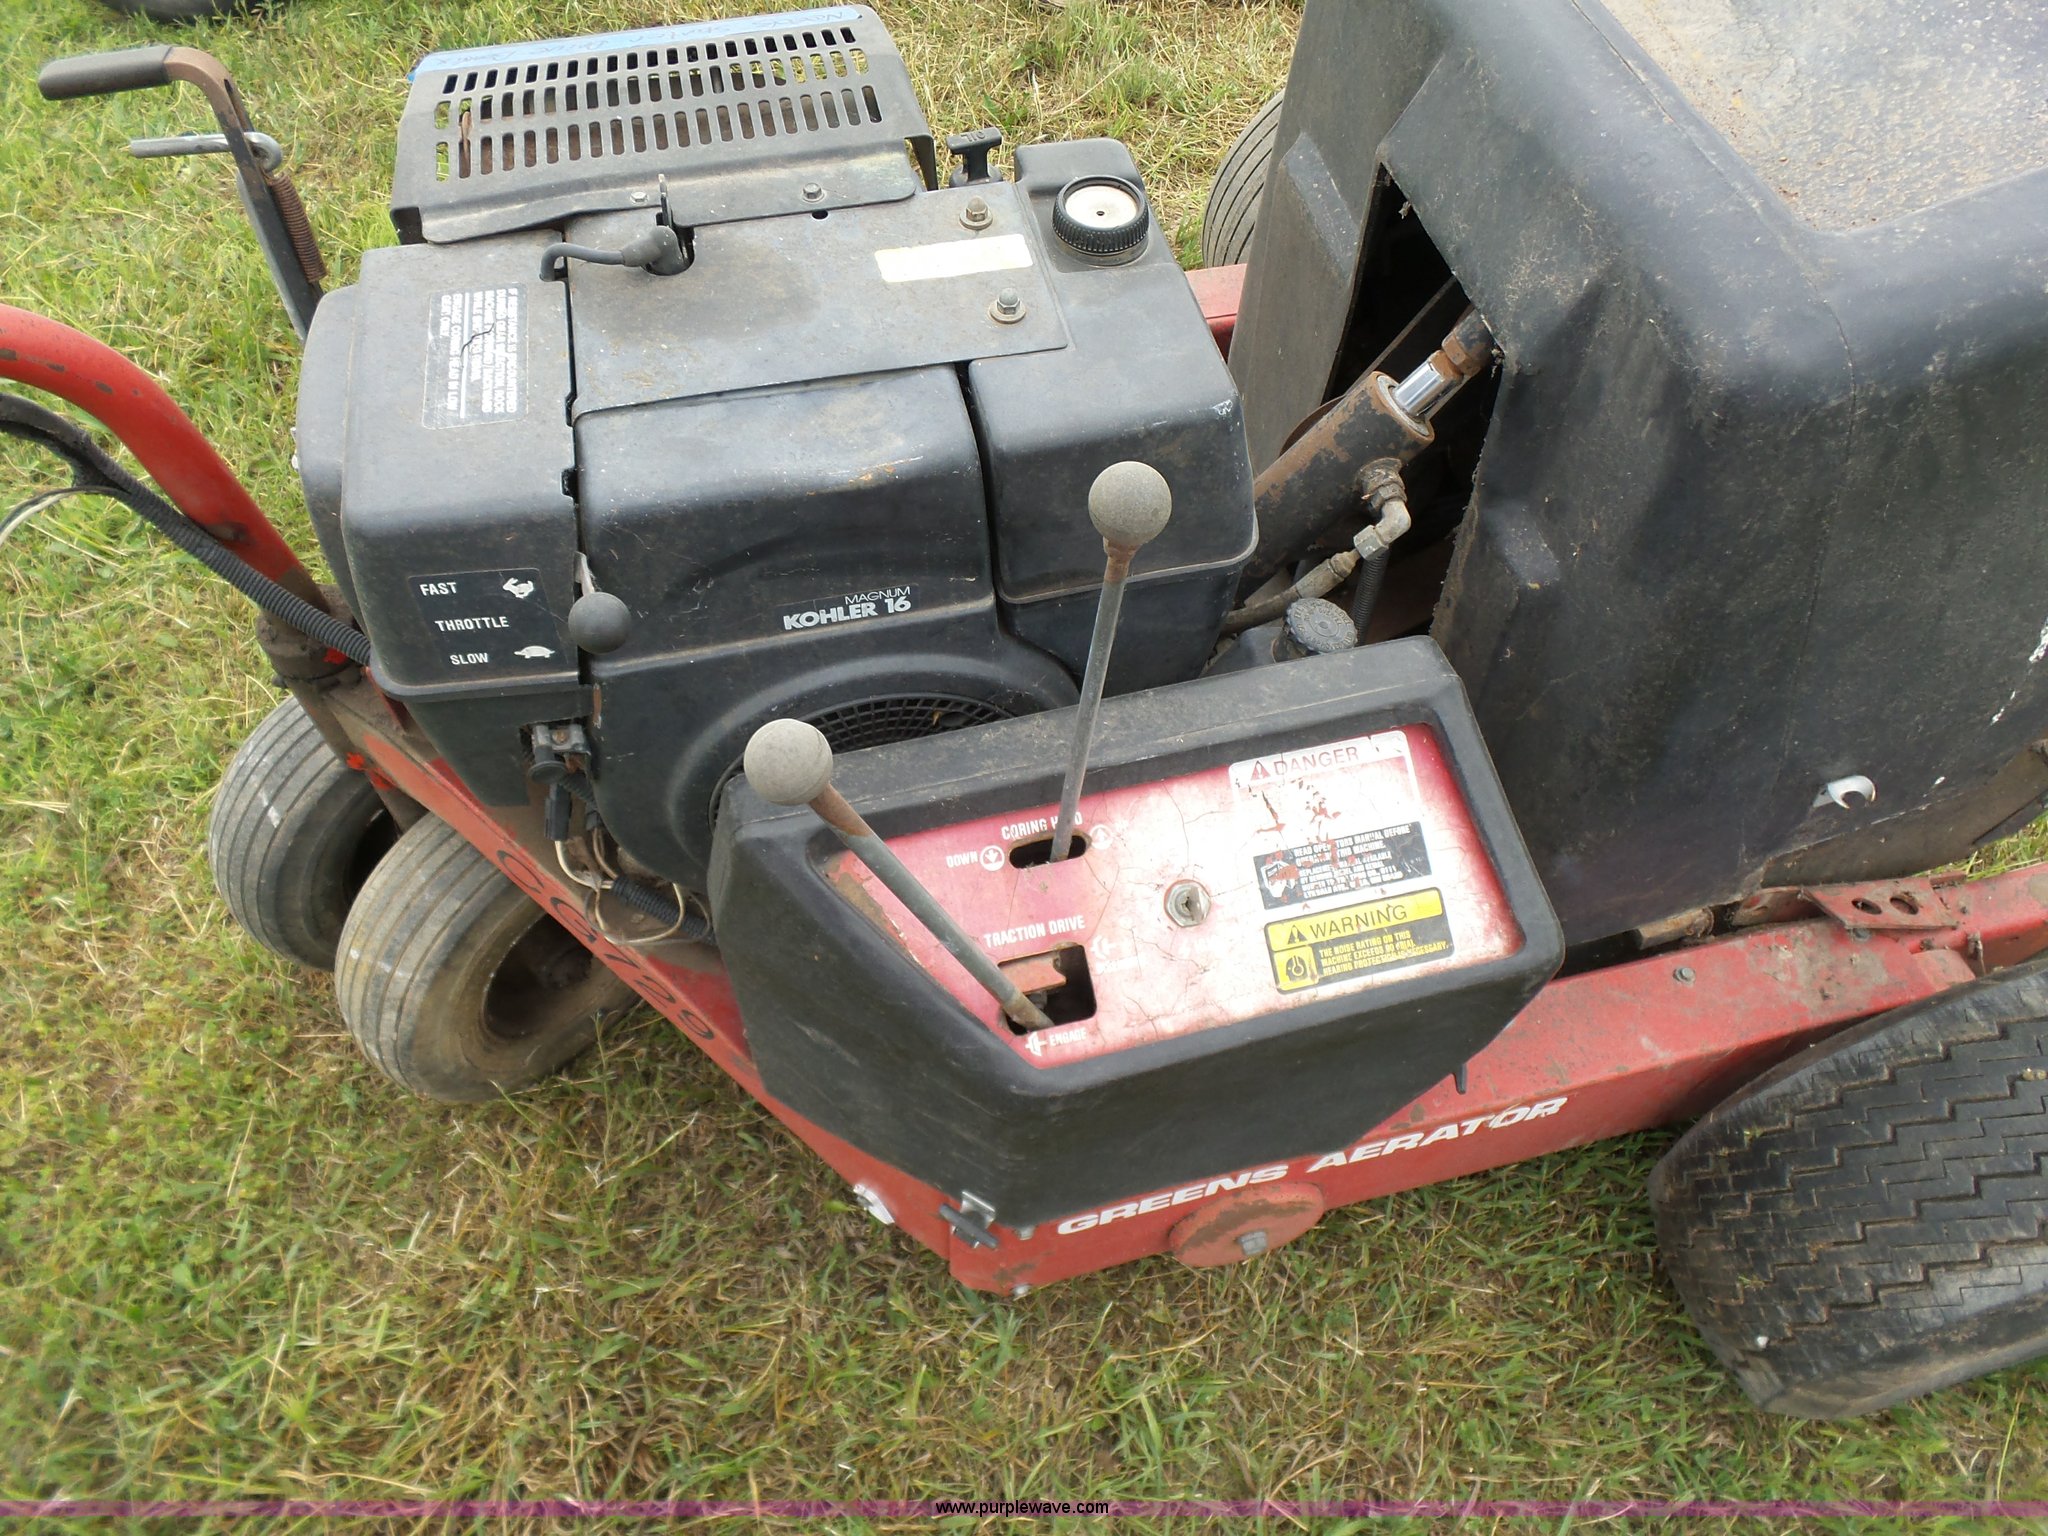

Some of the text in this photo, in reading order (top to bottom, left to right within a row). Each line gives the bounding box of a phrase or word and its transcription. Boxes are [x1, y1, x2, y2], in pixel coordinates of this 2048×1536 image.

[473, 292, 483, 314] WHILE
[484, 290, 494, 323] MACHINE
[496, 289, 506, 319] DURING
[508, 296, 518, 343] RESISTANCE
[496, 320, 506, 343] GEAR
[447, 294, 462, 410] ENGAGE CORING HEAD IN LOW
[507, 353, 517, 412] ENCOUNTERED
[494, 390, 505, 413] ROCK
[420, 582, 456, 596] FAST
[845, 586, 910, 605] MAGNUM
[435, 616, 509, 632] THROTTLE
[783, 596, 911, 630] KOHLER 16
[451, 653, 488, 665] SLOW
[1274, 746, 1359, 775] DANGER
[1002, 819, 1047, 839] CORING
[1354, 830, 1384, 844] MANUAL
[946, 851, 978, 868] DOWN
[984, 915, 1085, 948] TRACTION DRIVE
[1310, 905, 1407, 939] WARNING
[1320, 930, 1411, 958] THE NOISE RATING ON THIS
[1321, 953, 1352, 967] MACHINE
[1354, 946, 1383, 960] EXCEEDS
[1323, 962, 1353, 975] HEARING
[1048, 1028, 1086, 1046] ENGAGE
[1057, 1096, 1568, 1236] GREENS AERATOR
